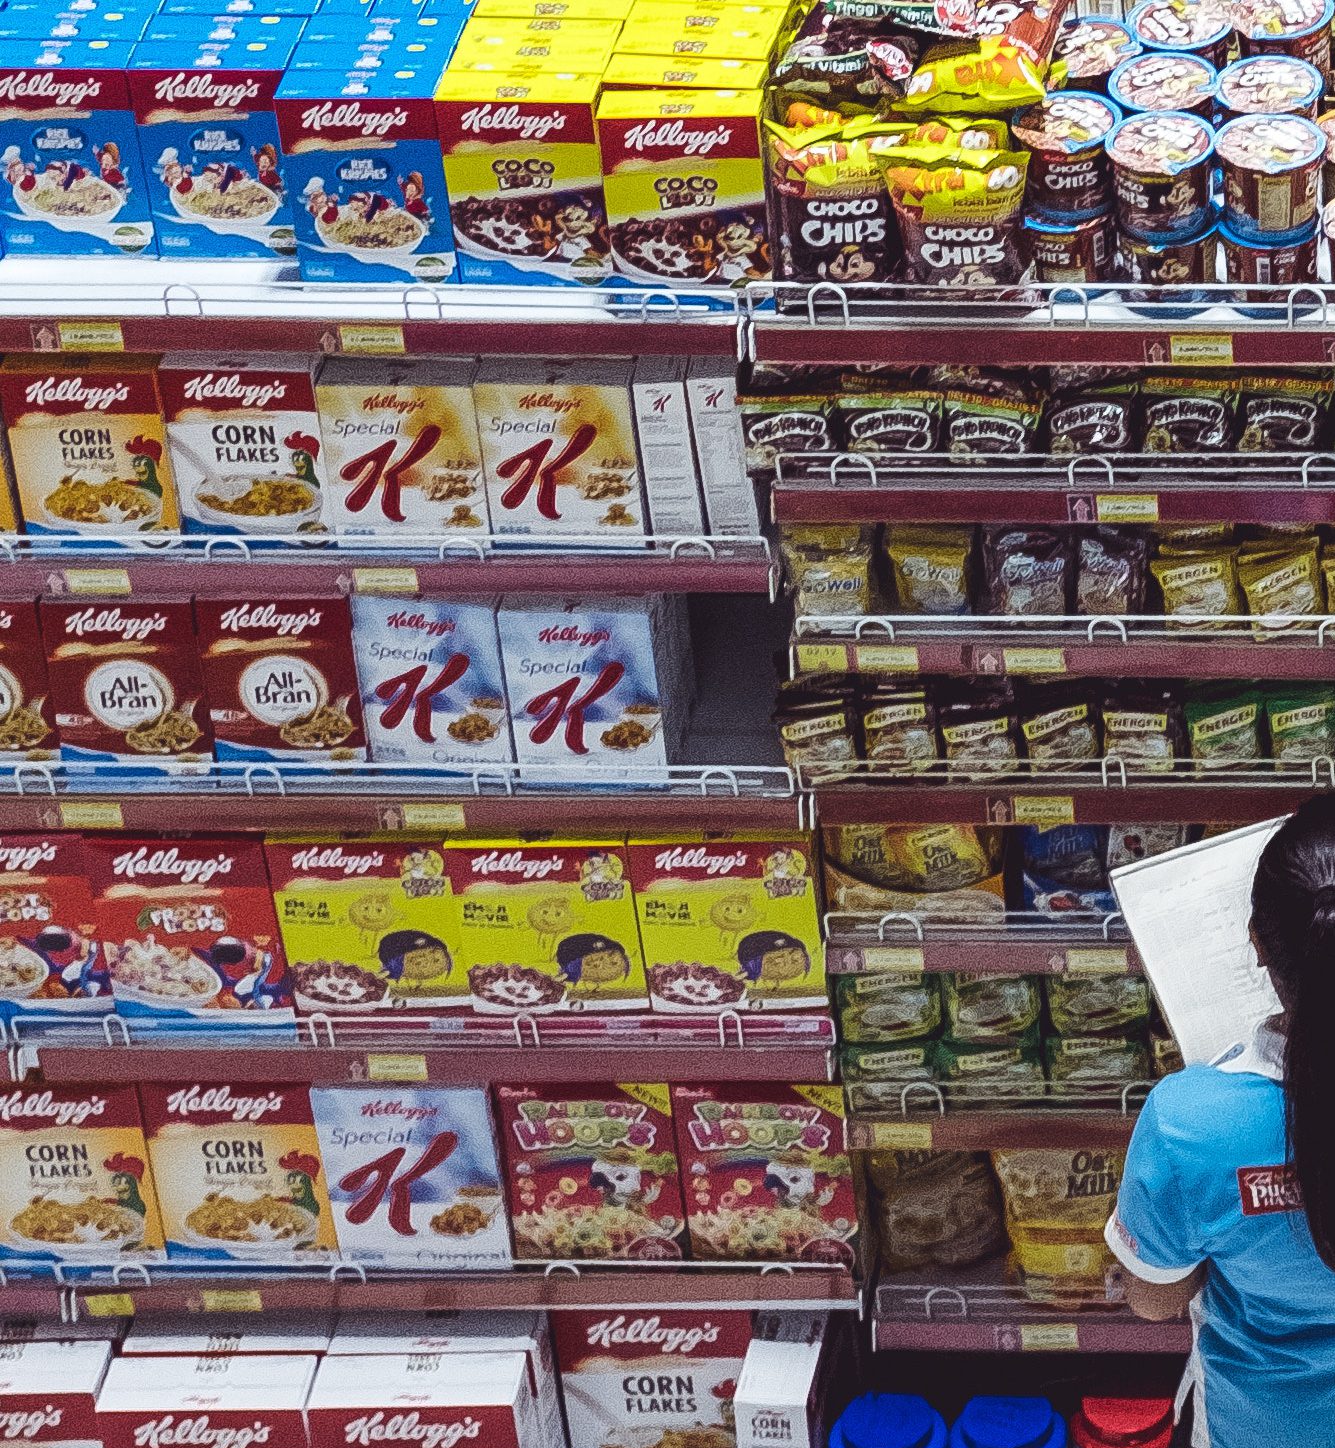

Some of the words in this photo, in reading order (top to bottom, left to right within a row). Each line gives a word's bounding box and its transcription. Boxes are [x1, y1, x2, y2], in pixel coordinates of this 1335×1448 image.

[0, 71, 102, 105] Kellogg's
[155, 73, 259, 106] Kellogg's
[302, 102, 408, 135] Kellogg's
[461, 104, 567, 138] Kellogg's
[624, 120, 732, 154] Kellogg's
[1049, 162, 1093, 173] CHOCO
[1045, 173, 1097, 189] CHIPS
[807, 200, 878, 216] CHOCO
[801, 219, 885, 246] CHIPS
[925, 227, 994, 241] CHOCO
[921, 242, 1005, 268] CHIPS
[26, 377, 129, 409] Kellogg's
[184, 374, 286, 406] Kellogg's
[362, 393, 426, 414] Kellogg's
[518, 393, 582, 414] Kellogg's
[59, 429, 111, 445] CORN
[212, 425, 275, 444] CORN
[331, 417, 400, 438] Special
[490, 416, 557, 435] Special
[62, 447, 114, 459] FLAKES
[216, 447, 279, 462] FLAKES
[340, 423, 443, 522] K
[496, 423, 598, 520] K
[65, 609, 166, 640] Kellogg's
[221, 605, 321, 635] Kellogg's
[387, 611, 457, 636] Kellogg's
[539, 624, 611, 646] Kellogg's
[368, 641, 434, 665] Special
[518, 655, 587, 680] Special
[98, 686, 158, 713] Bran
[253, 682, 313, 709] Bran
[374, 653, 471, 743] K
[525, 660, 626, 755] K
[113, 847, 233, 883] Kellogg's
[292, 847, 383, 879] Kellogg's
[472, 850, 564, 880] Kellogg's
[655, 847, 747, 879] Kellogg's
[168, 1086, 283, 1121] Kellogg's
[360, 1101, 439, 1122] Kellogg's
[202, 1141, 263, 1158] CORN
[333, 1128, 413, 1148] Special
[26, 1144, 88, 1162] CORN
[30, 1164, 92, 1177] FLAKES
[206, 1161, 267, 1174] FLAKES
[338, 1130, 459, 1236] K
[588, 1316, 720, 1352] Kellogg's
[623, 1376, 693, 1395] CORN
[626, 1394, 697, 1412] FLAKES
[750, 1414, 793, 1430] CORN
